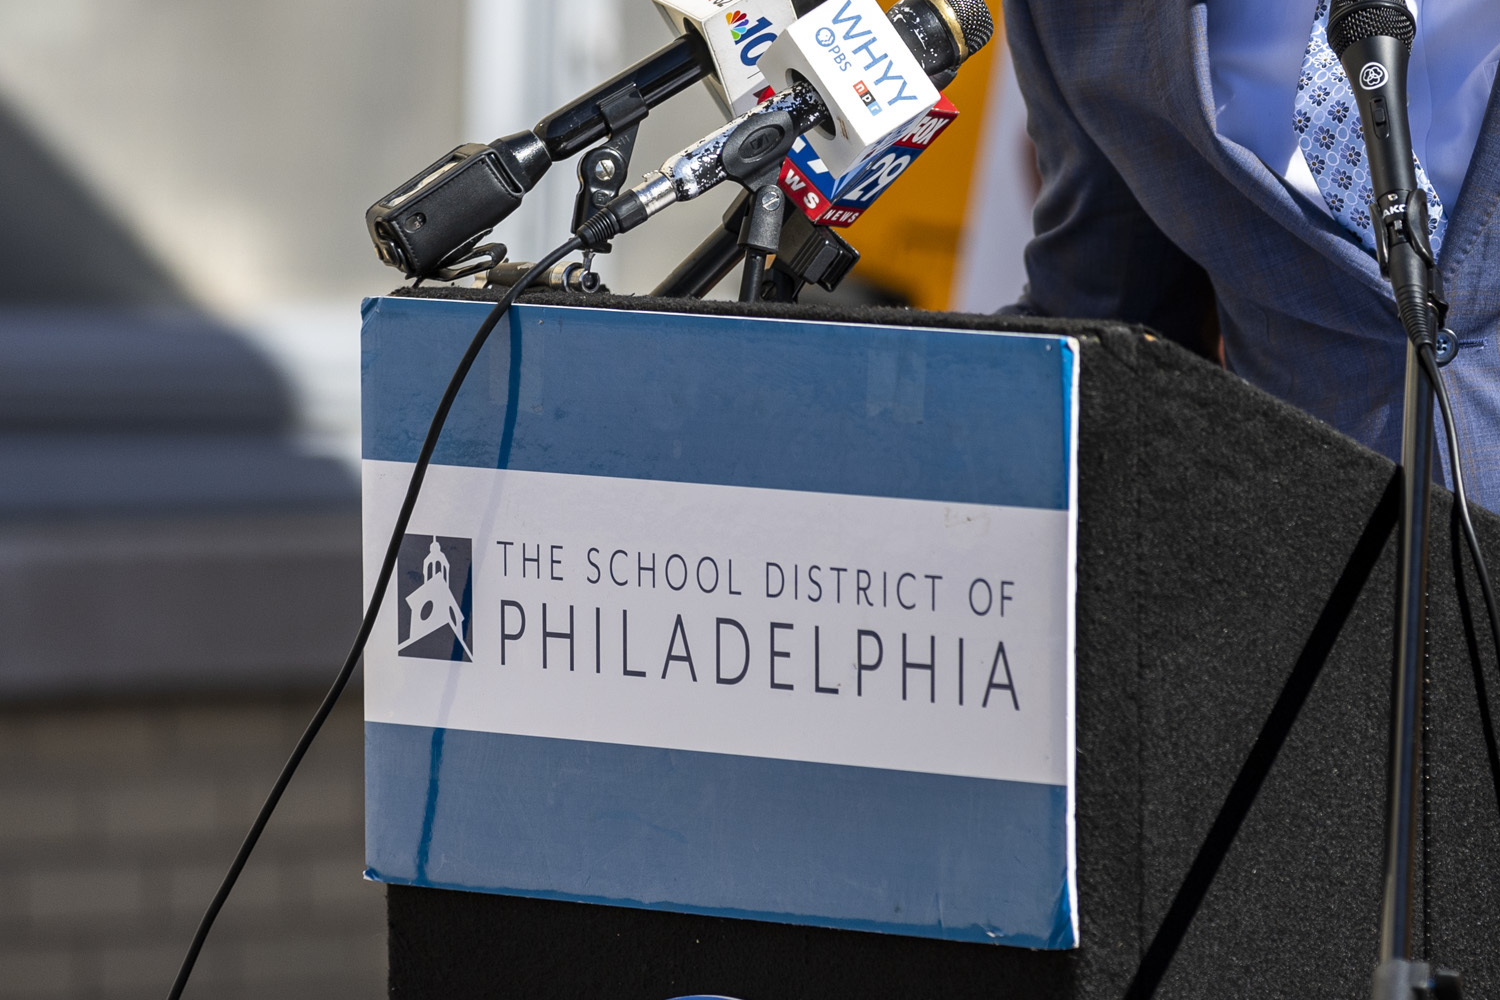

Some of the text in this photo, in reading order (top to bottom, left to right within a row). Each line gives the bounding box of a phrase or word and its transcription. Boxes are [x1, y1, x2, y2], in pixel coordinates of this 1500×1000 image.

[733, 16, 778, 67] 10
[828, 44, 852, 72] PBS
[853, 81, 882, 115] npr
[901, 116, 950, 146] FOX
[784, 168, 820, 210] WS
[842, 152, 911, 202] 29
[822, 208, 860, 223] NEWS
[496, 540, 1016, 619] THE SCHOOL DISTRICT OF
[499, 599, 1021, 712] PHILADELPHIA
